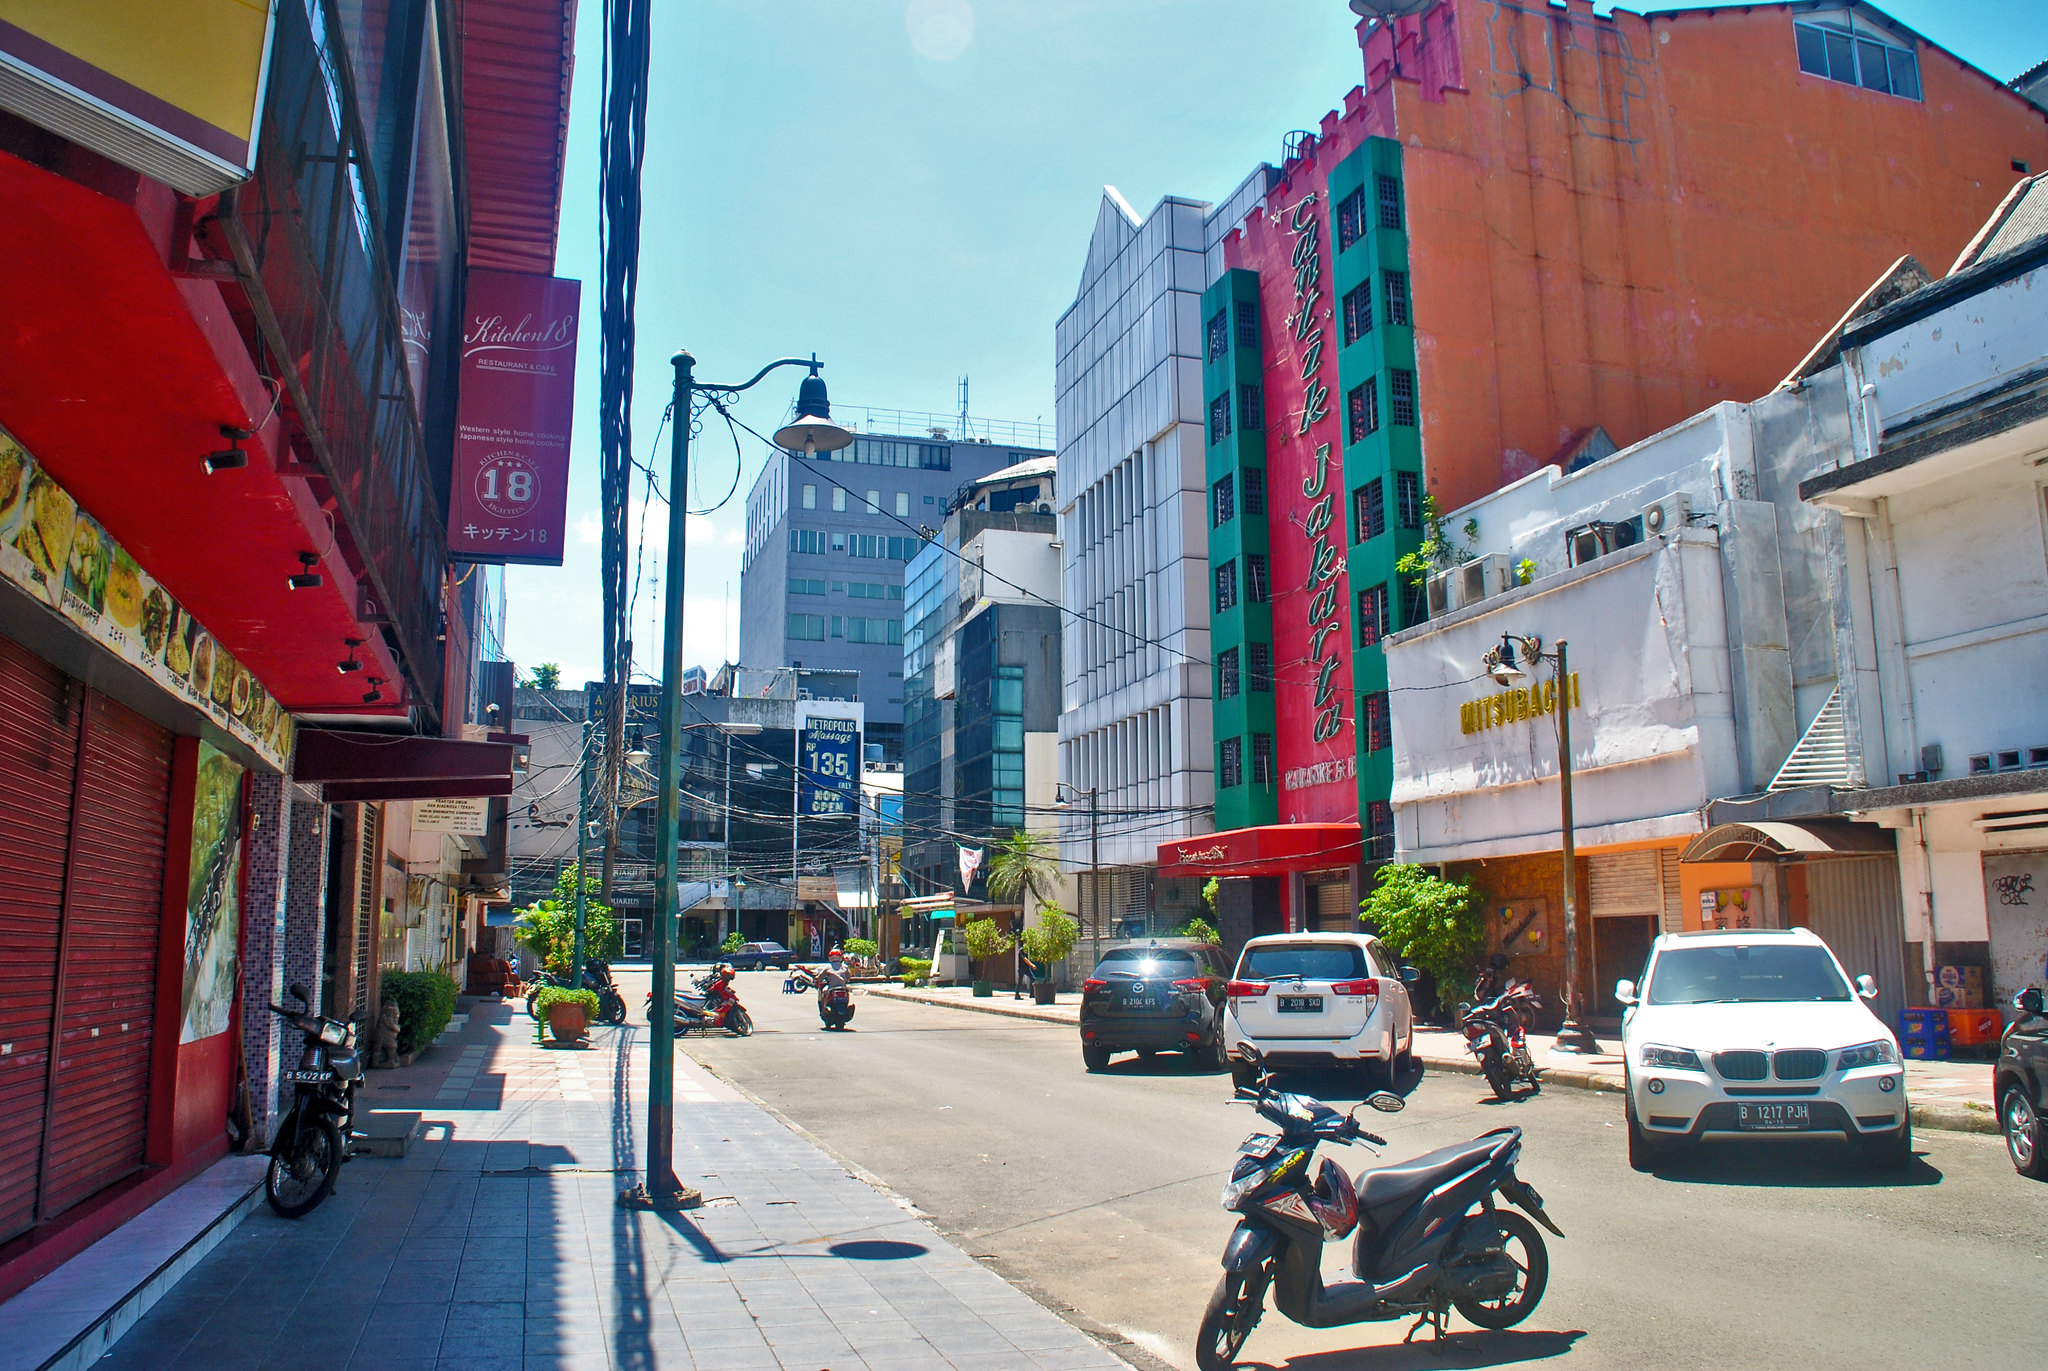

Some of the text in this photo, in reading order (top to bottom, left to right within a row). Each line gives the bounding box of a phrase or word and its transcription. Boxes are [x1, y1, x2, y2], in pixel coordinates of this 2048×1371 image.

[478, 358, 528, 370] RESTAURANT
[535, 363, 556, 372] CAFE
[460, 424, 566, 442] Western style home cooking
[460, 433, 565, 449] Japanese style home cooking
[479, 450, 514, 466] KITCHEN
[1291, 190, 1344, 744] Cantik Jakarta
[482, 468, 533, 502] 18
[488, 502, 526, 515] EIGHTEEN
[463, 523, 548, 544] キッチン18
[808, 718, 855, 733] METROPOLIS
[809, 729, 854, 745] Massage
[806, 742, 817, 752] RP
[810, 751, 849, 776] 135
[814, 790, 841, 801] NOW
[811, 801, 844, 812] OPEN
[1279, 999, 1285, 1007] B
[286, 1071, 294, 1080] B
[1740, 1105, 1808, 1119] B 1217 PJH
